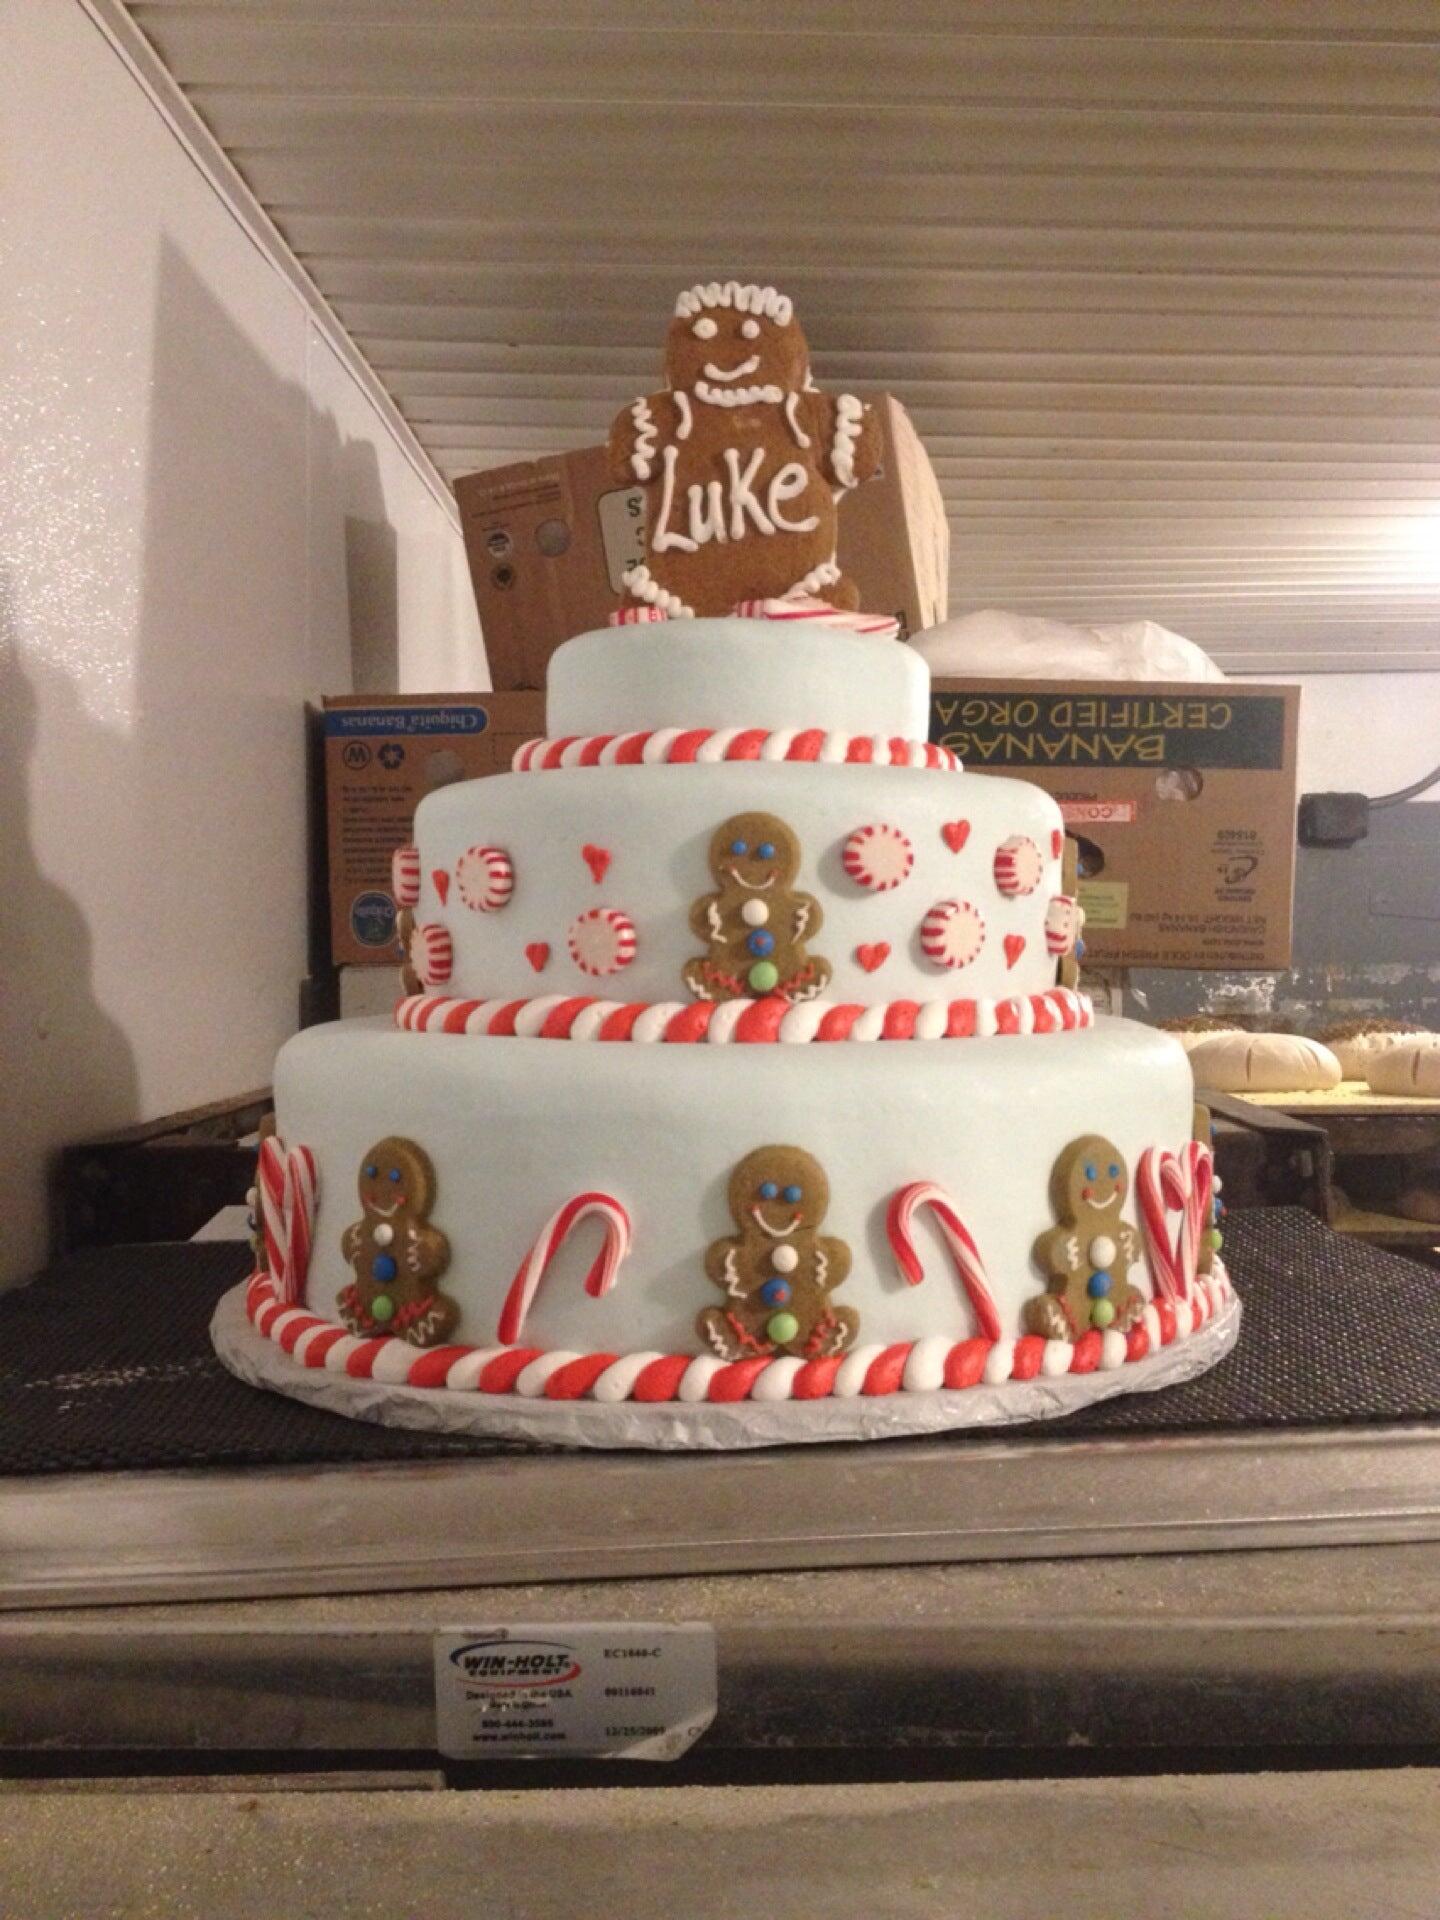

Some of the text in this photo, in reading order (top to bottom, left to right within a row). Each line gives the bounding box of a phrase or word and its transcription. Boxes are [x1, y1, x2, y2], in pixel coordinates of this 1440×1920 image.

[342, 714, 405, 728] Bananas
[1050, 701, 1233, 730] CERTIFIED
[937, 732, 1166, 761] BANANAS
[464, 1655, 569, 1668] WIN-HOLT
